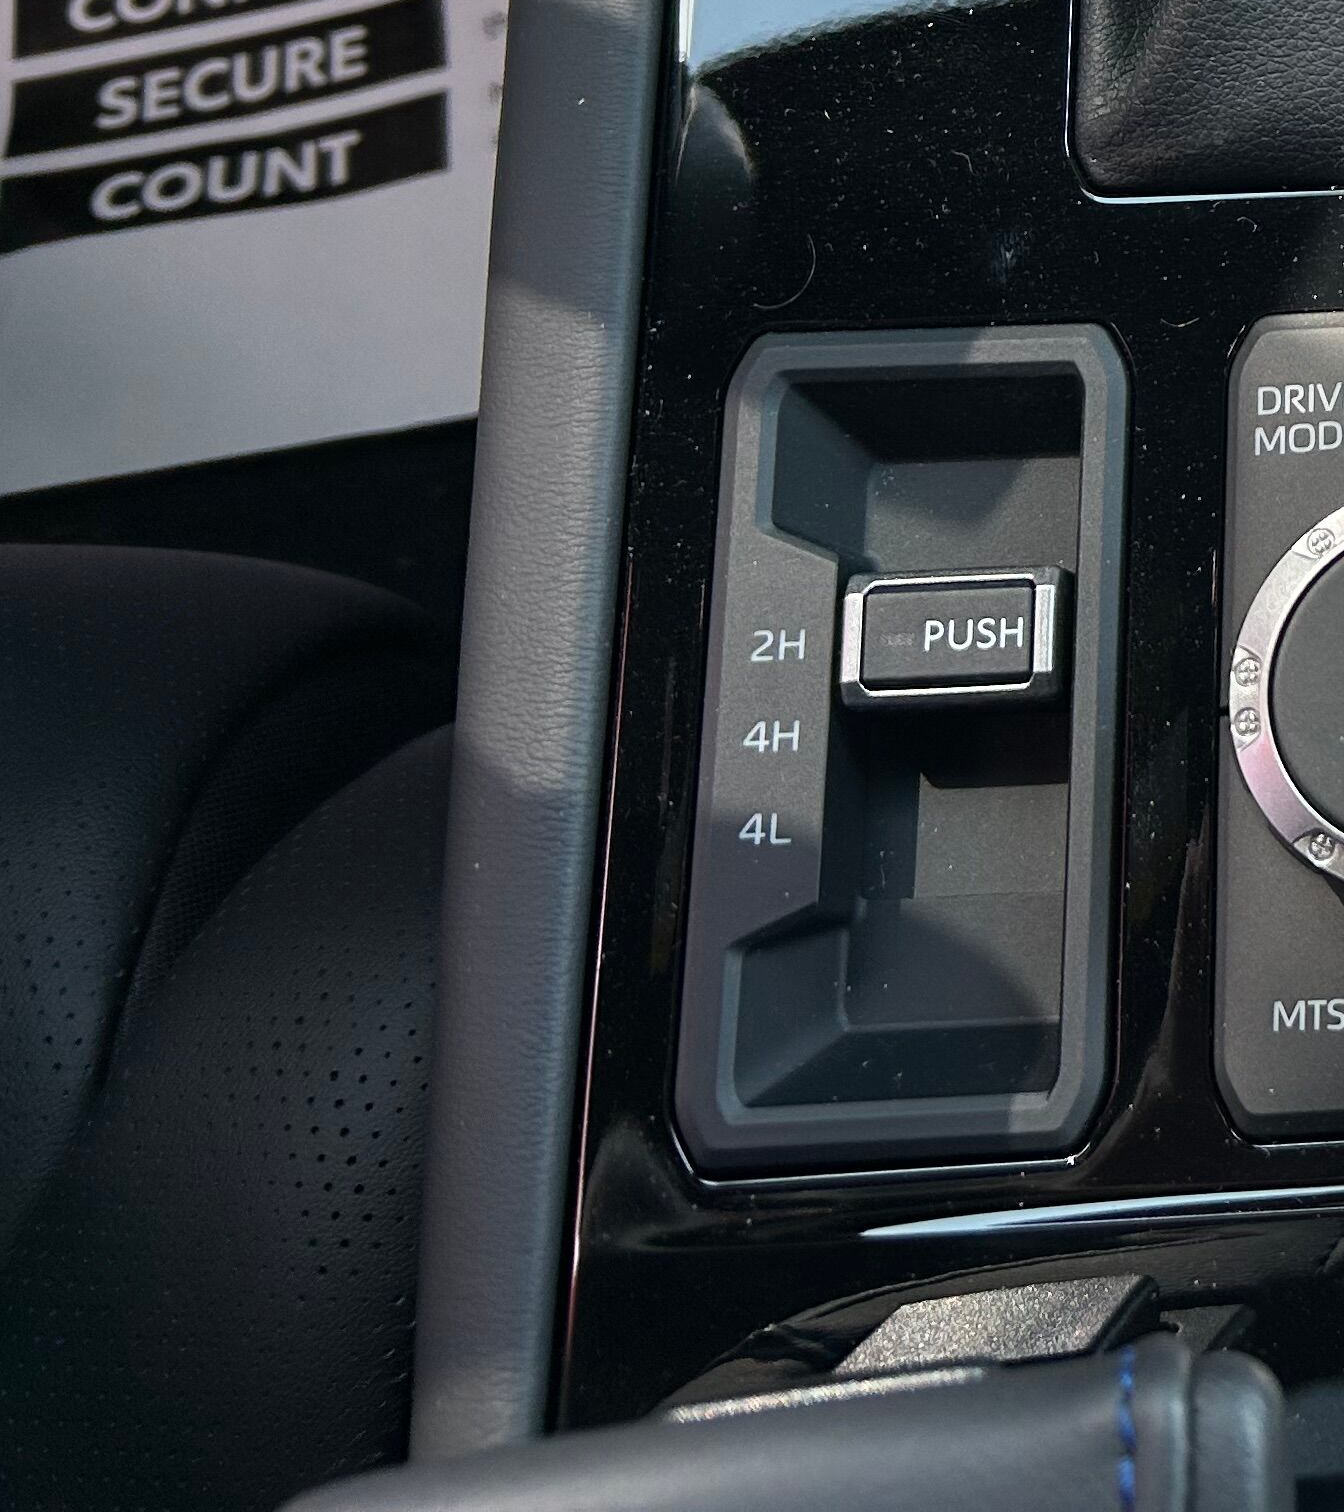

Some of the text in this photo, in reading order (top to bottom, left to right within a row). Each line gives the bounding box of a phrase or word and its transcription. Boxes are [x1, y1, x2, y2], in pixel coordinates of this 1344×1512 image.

[93, 24, 369, 131] SECURE
[89, 128, 362, 222] COUNT
[750, 628, 806, 663] 2H
[923, 616, 1025, 652] PUSH
[742, 719, 801, 754] 4H
[738, 812, 792, 846] 4L
